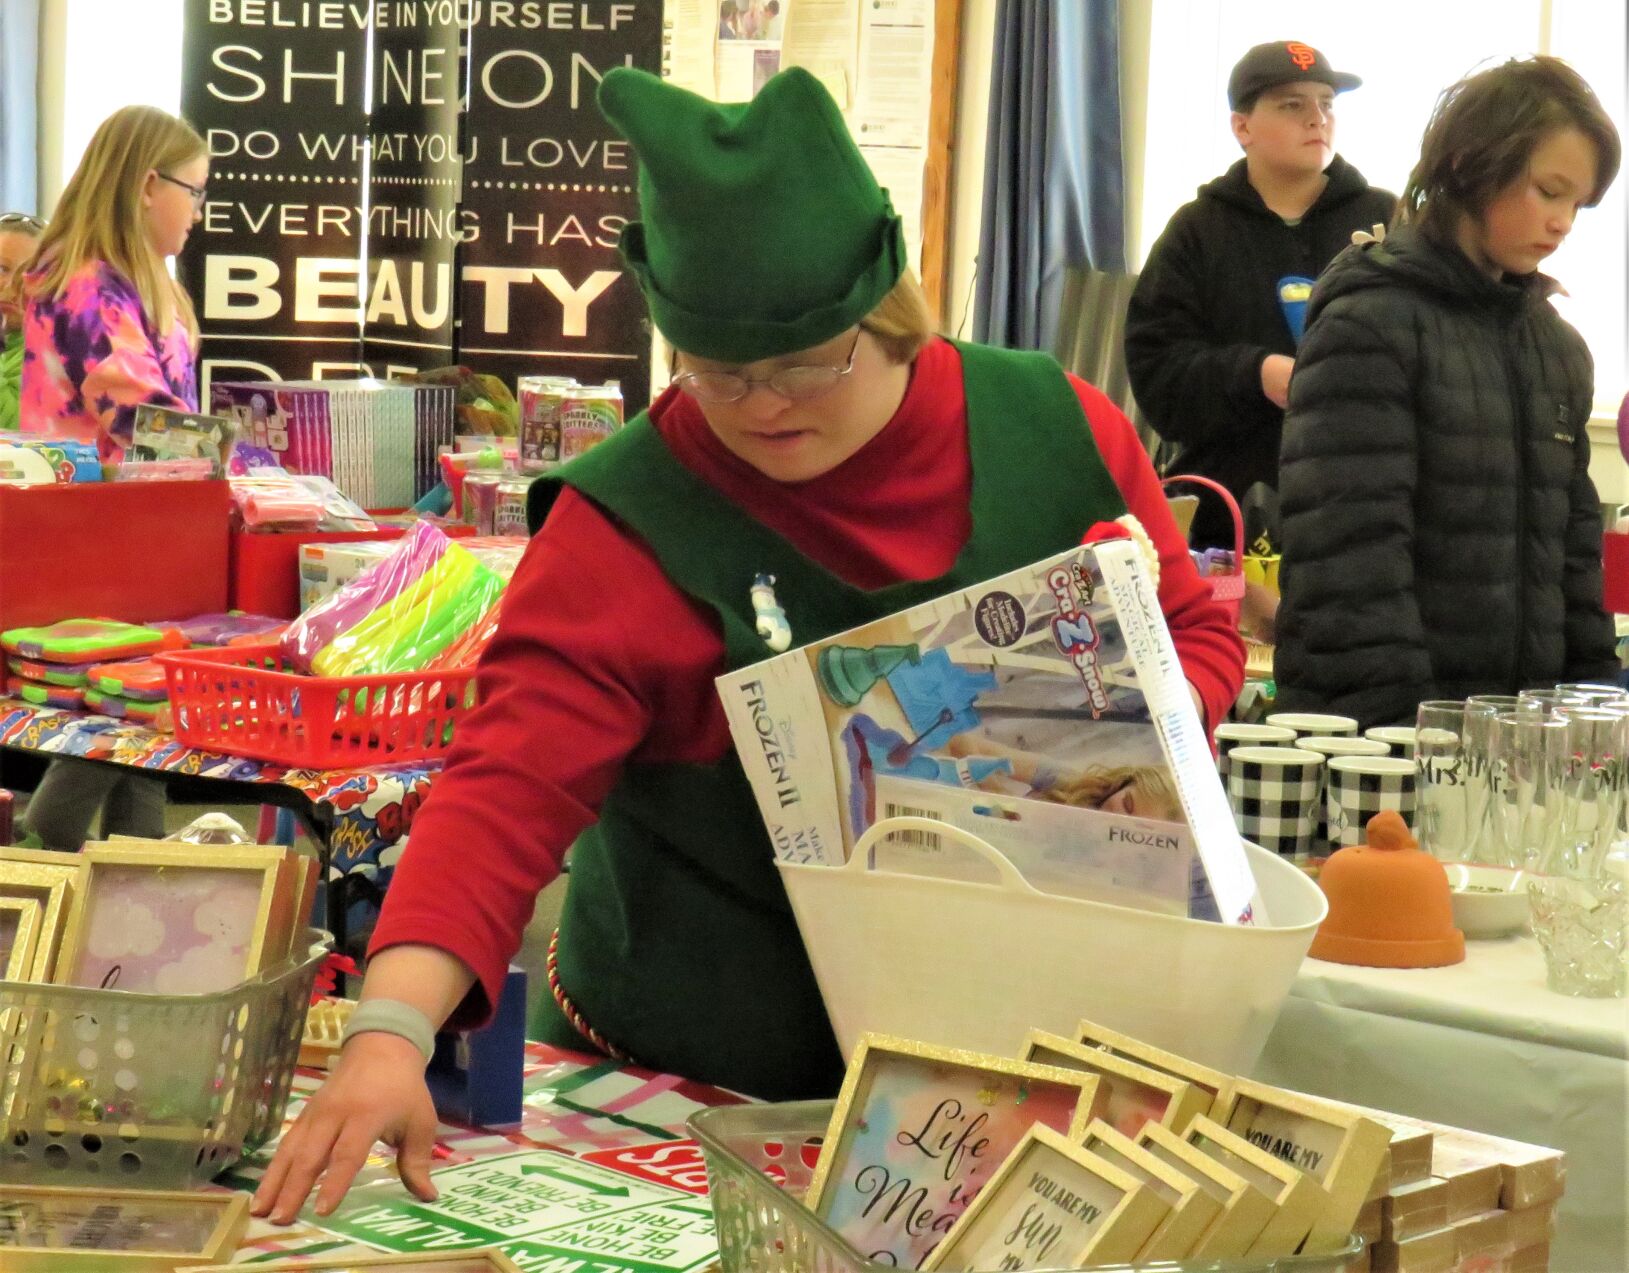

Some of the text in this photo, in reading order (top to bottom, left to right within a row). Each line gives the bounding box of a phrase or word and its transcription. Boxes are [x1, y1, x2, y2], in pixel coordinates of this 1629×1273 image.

[209, 0, 635, 31] BELIEVE IN YOURSELF
[206, 45, 446, 105] SHNE
[207, 128, 629, 170] DO WHAT YOU LOVE
[203, 202, 630, 248] EVERYTHING HAS
[204, 254, 622, 337] BEAUTY
[740, 680, 790, 784] FROZEN
[1108, 825, 1180, 850] FROZEN
[896, 1098, 991, 1181] Life
[1272, 1138, 1298, 1163] ARE
[1299, 1148, 1324, 1171] MY
[450, 1183, 550, 1214] BE KIND
[458, 1168, 580, 1203] FRIENDLY
[1028, 1172, 1103, 1226] YOU ARE MY
[480, 1212, 529, 1229] BE
[563, 1198, 612, 1213] BE
[538, 1229, 680, 1261] BE HONE
[574, 1220, 680, 1244] BE KIN
